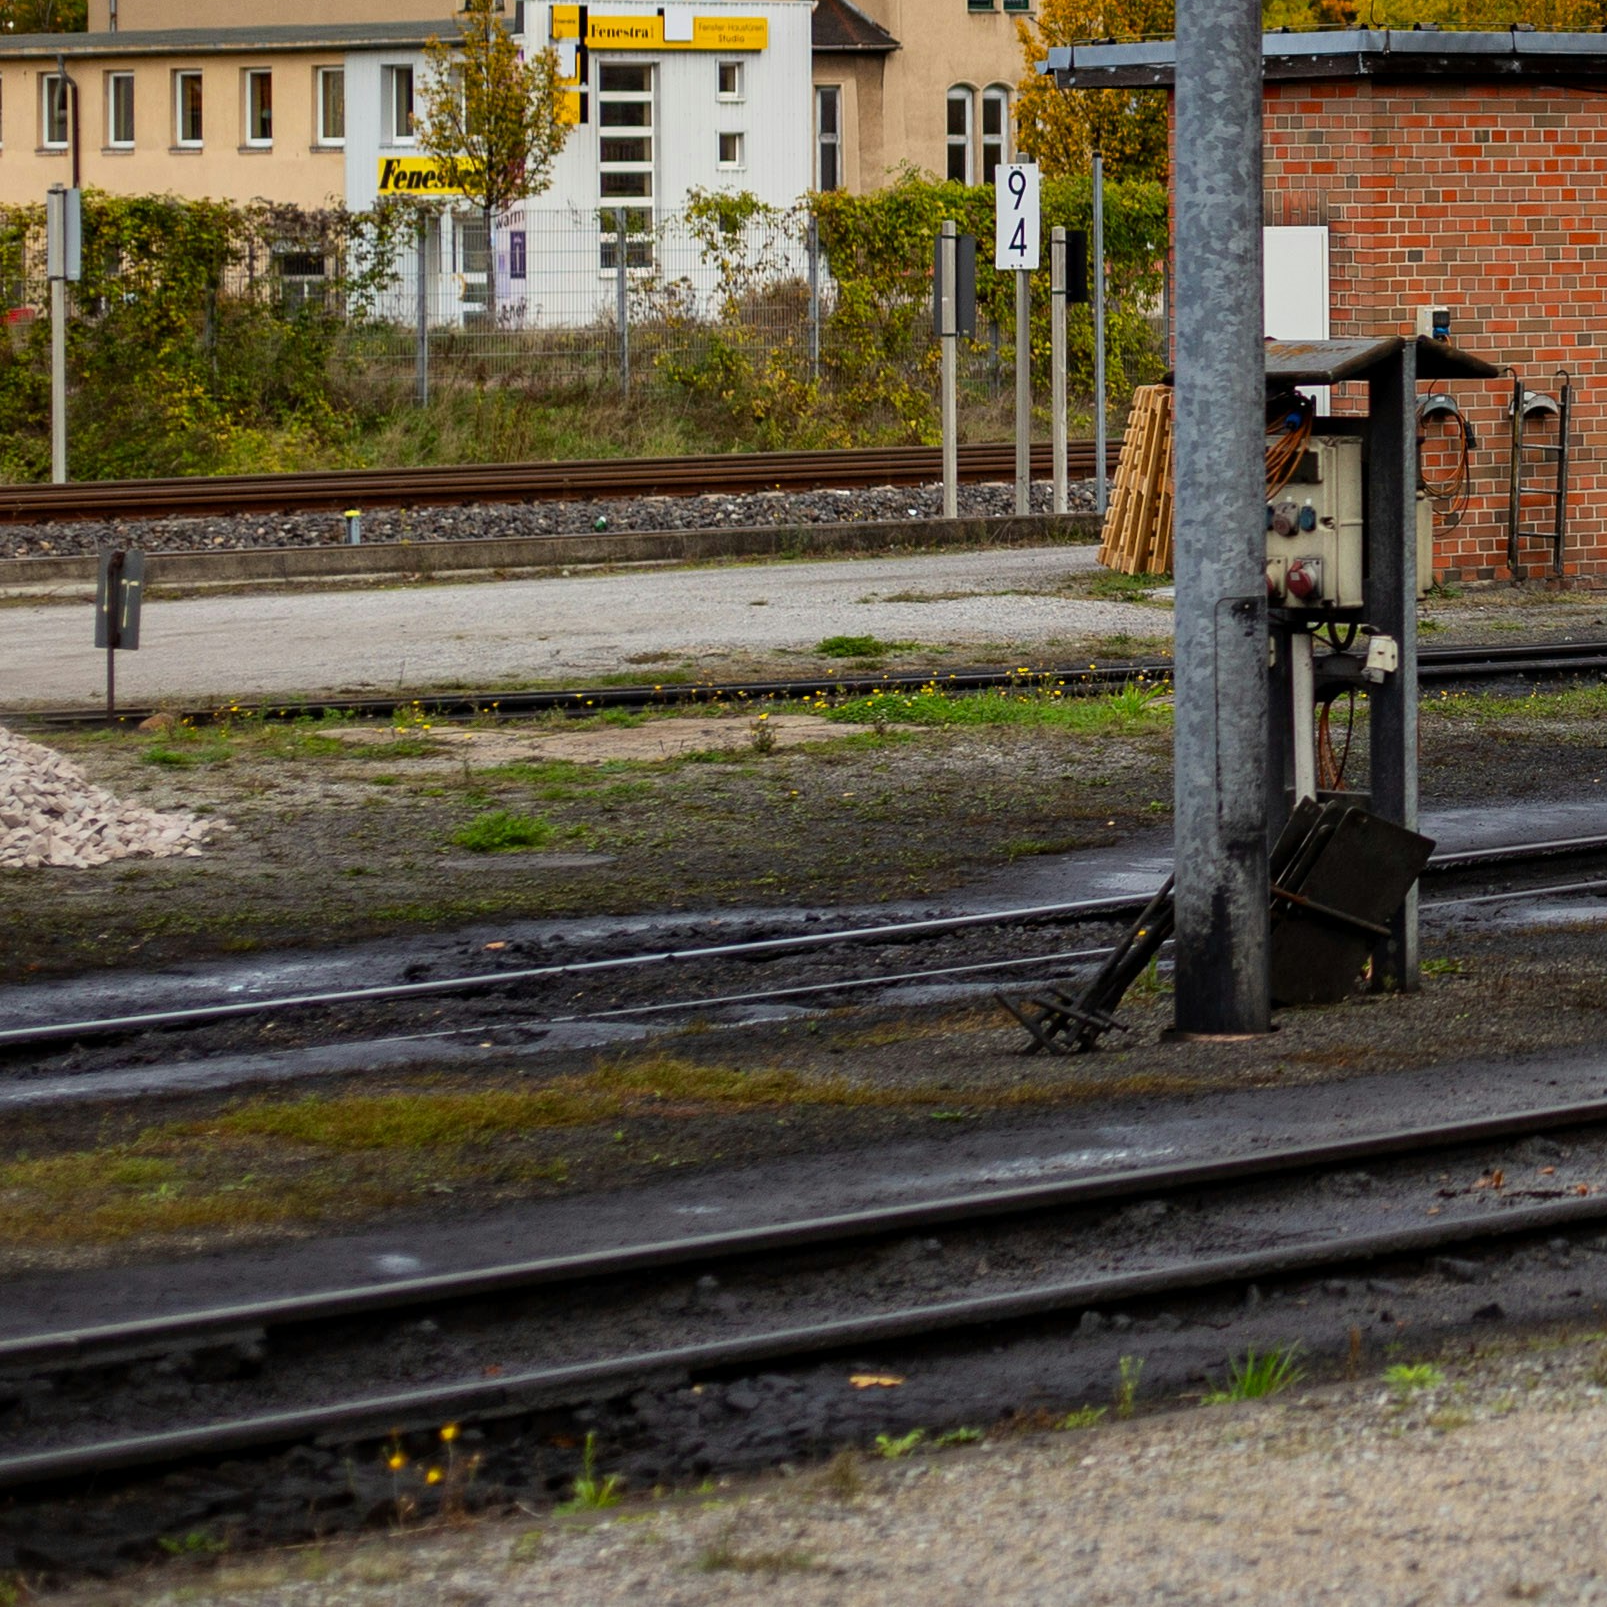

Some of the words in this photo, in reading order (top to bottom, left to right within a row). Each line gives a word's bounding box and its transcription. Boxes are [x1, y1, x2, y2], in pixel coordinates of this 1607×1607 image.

[590, 23, 649, 38] Fenestra
[1008, 170, 1026, 210] 9
[1008, 217, 1027, 257] 4
